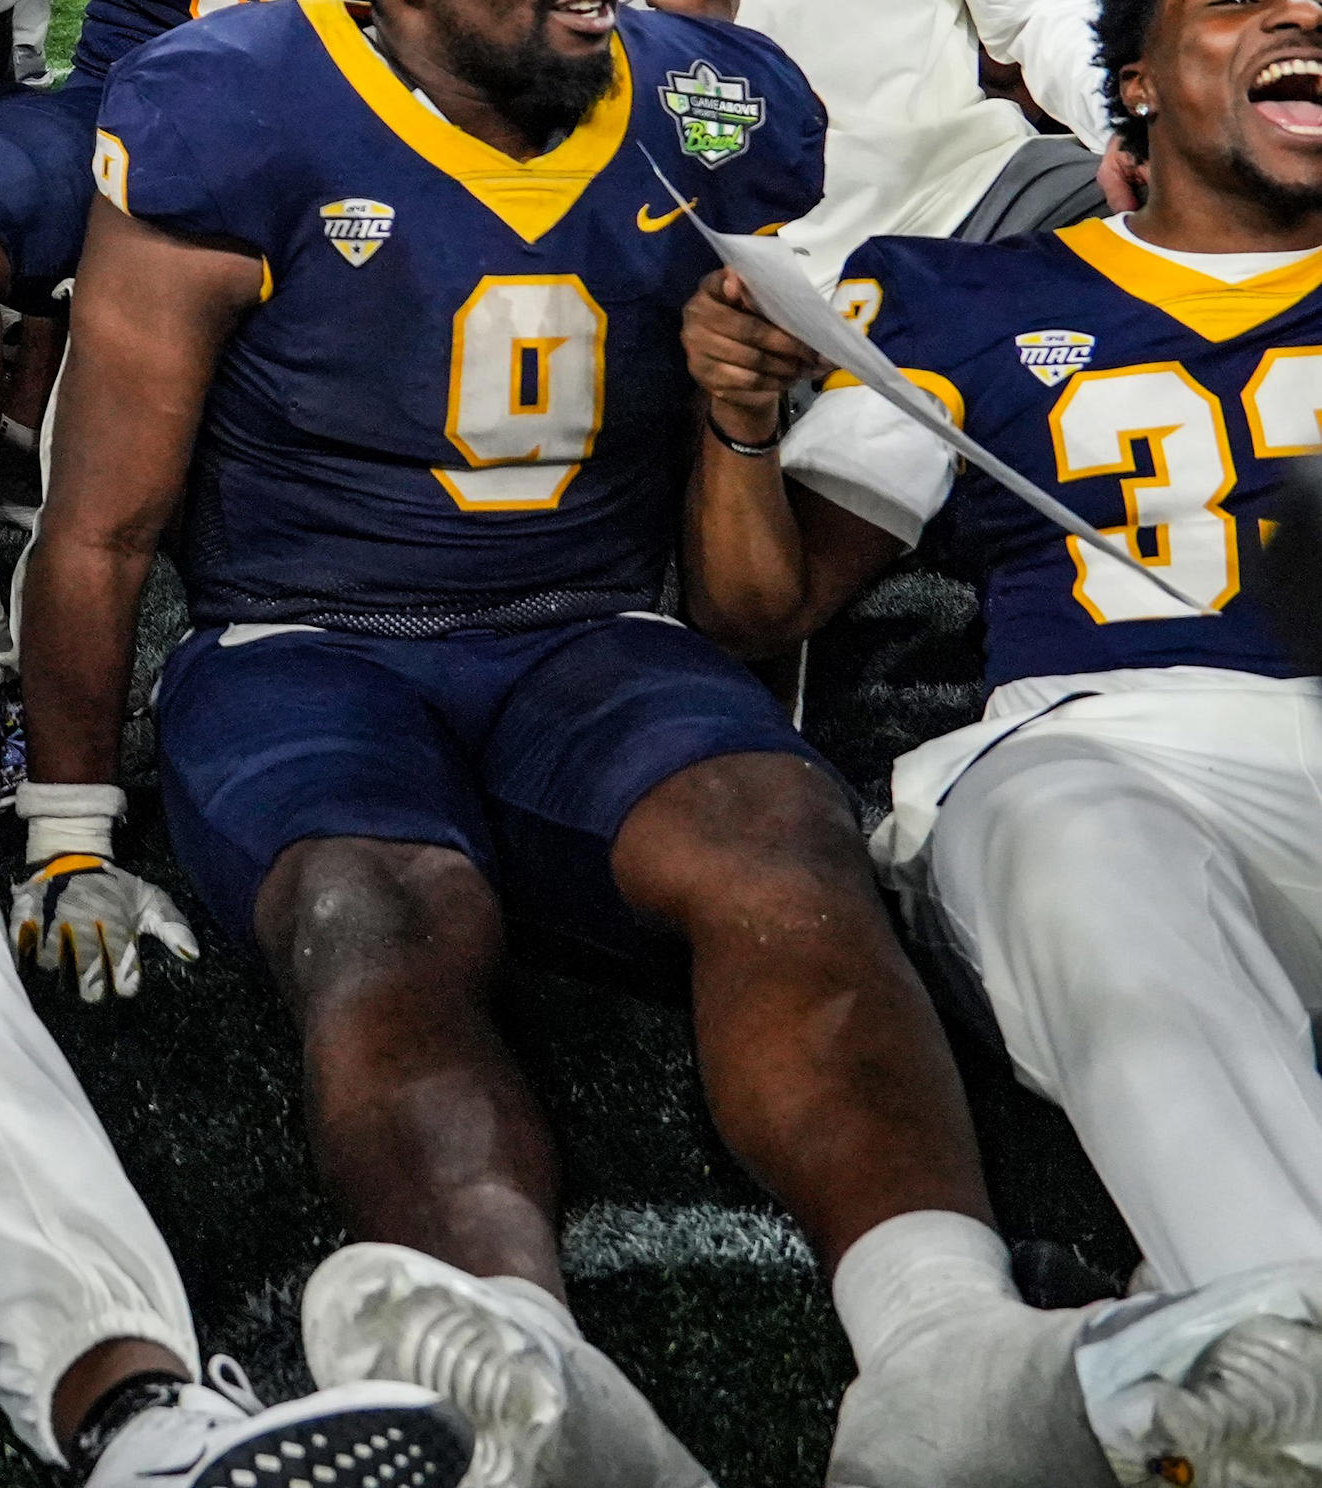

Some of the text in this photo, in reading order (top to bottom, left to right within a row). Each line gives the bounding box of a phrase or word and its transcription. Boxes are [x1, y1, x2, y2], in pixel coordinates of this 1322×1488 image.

[689, 97, 758, 116] GAMEABOVE
[684, 121, 742, 152] Bowl
[324, 218, 393, 239] MAC
[1019, 346, 1092, 365] MAC
[430, 274, 608, 512] 9
